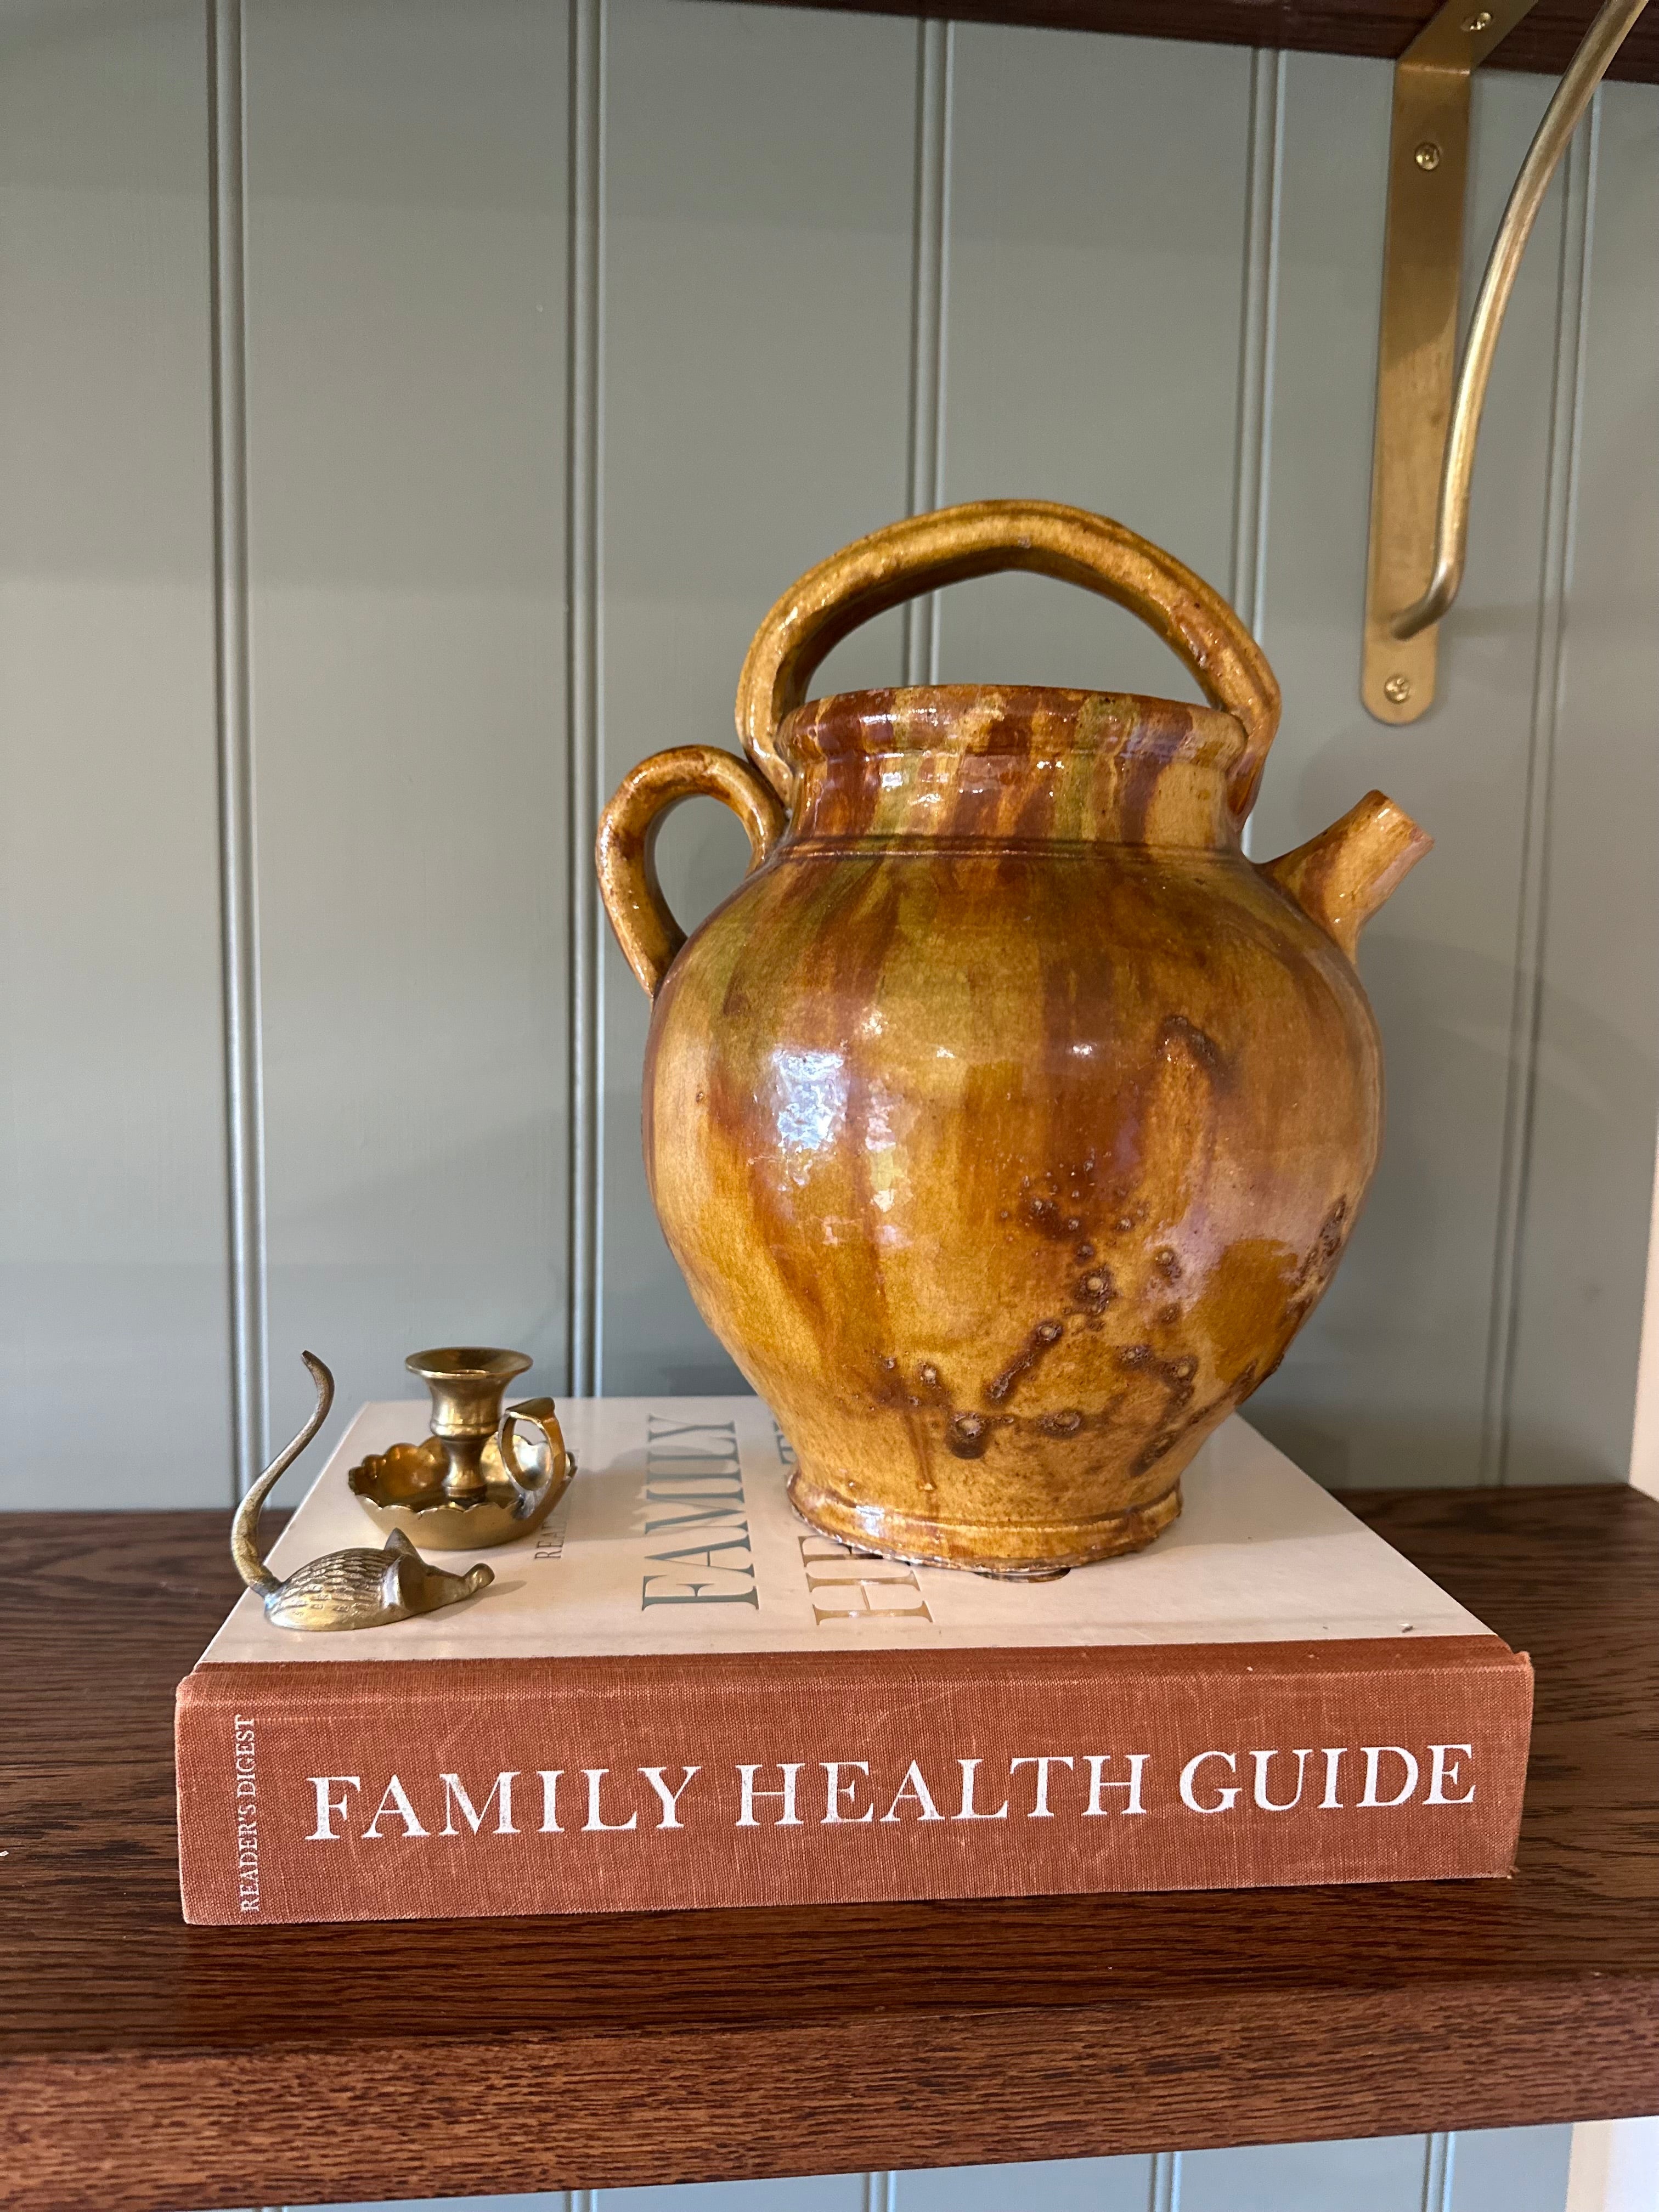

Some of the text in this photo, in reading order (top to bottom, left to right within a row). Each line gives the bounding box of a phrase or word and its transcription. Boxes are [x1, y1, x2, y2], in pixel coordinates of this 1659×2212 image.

[641, 1413, 759, 1611] FAMILY
[235, 1714, 259, 1912] READER'S DIGEST
[304, 1743, 1476, 1841] FAMILY HEALTH GUIDE
